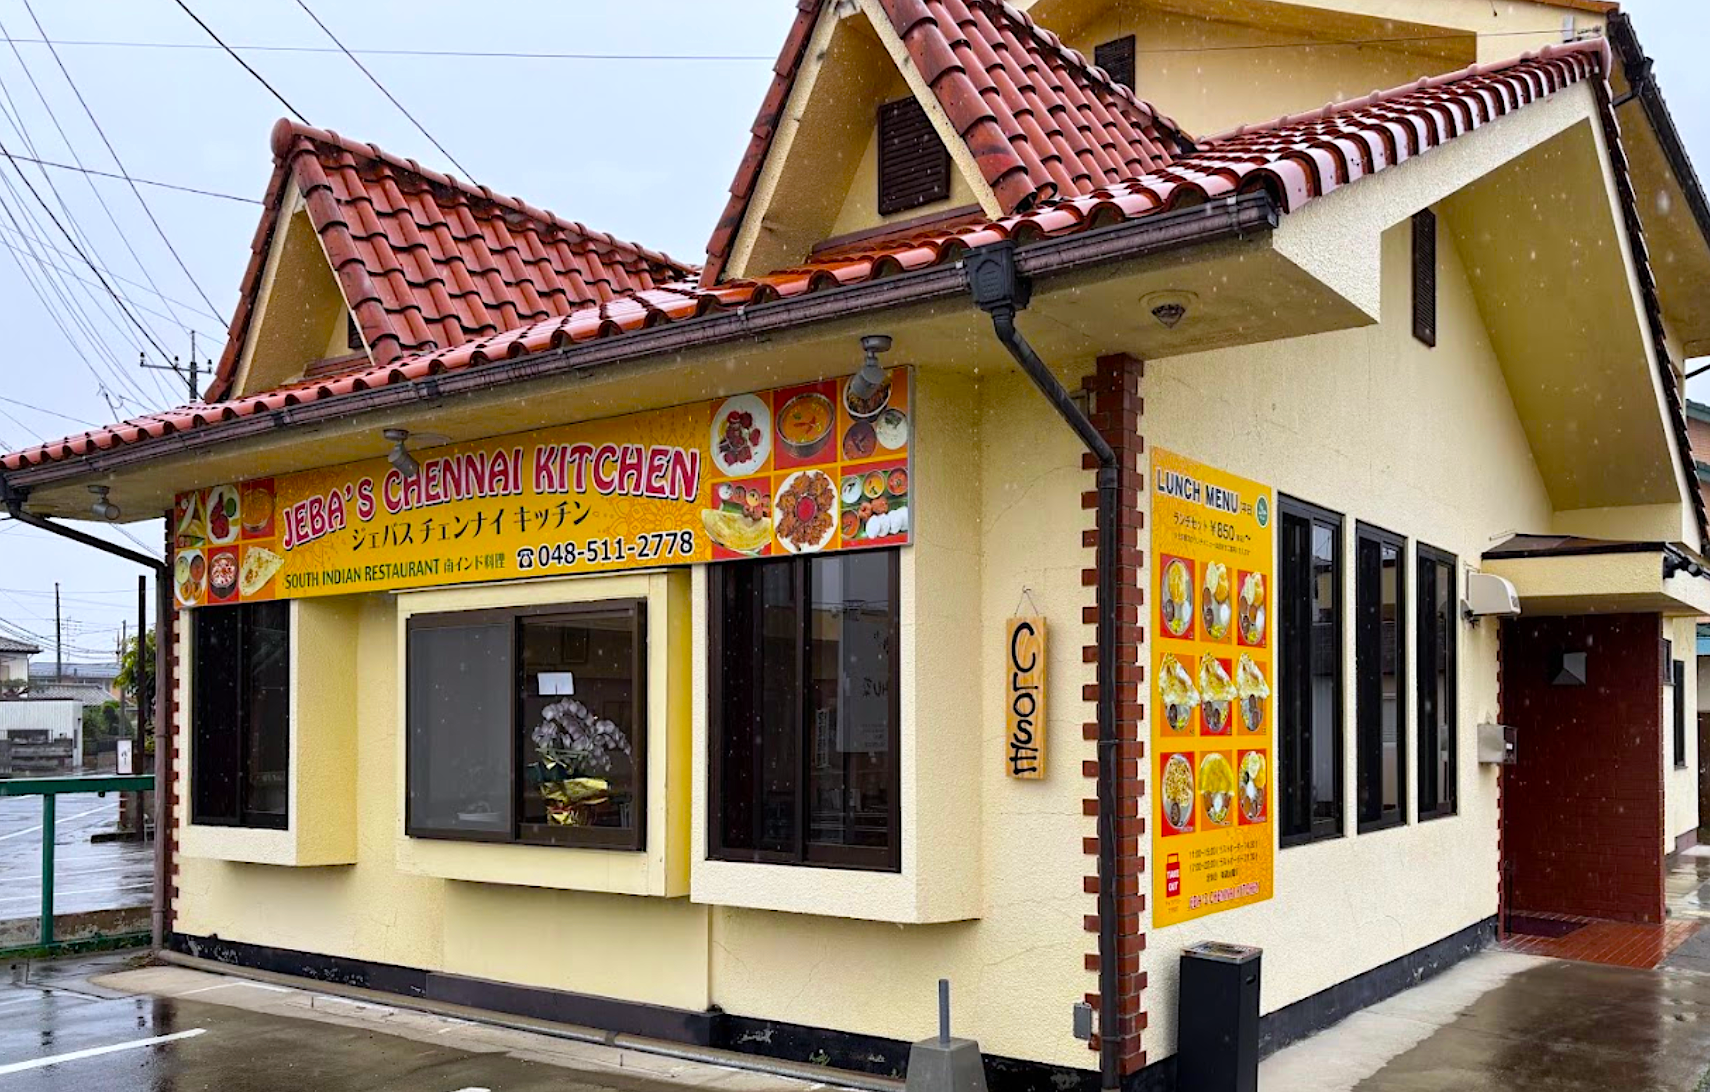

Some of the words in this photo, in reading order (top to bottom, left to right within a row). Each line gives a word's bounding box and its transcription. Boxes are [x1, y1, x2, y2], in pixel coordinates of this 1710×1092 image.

[283, 477, 376, 551] JEBA'S
[383, 447, 524, 514] CHENNAI
[532, 442, 702, 503] KITCHEN
[1157, 467, 1201, 503] LUNCH
[1205, 483, 1239, 514] MENU
[419, 507, 504, 545] チェンナイ
[513, 500, 593, 534] キッチン
[285, 572, 319, 589] SOUTH
[322, 567, 361, 585] INDIAN
[365, 558, 440, 582] RESTAURANT
[443, 553, 505, 575] 南インド料理
[537, 530, 694, 568] 048-511-2778
[1009, 621, 1039, 776] CLOSE
